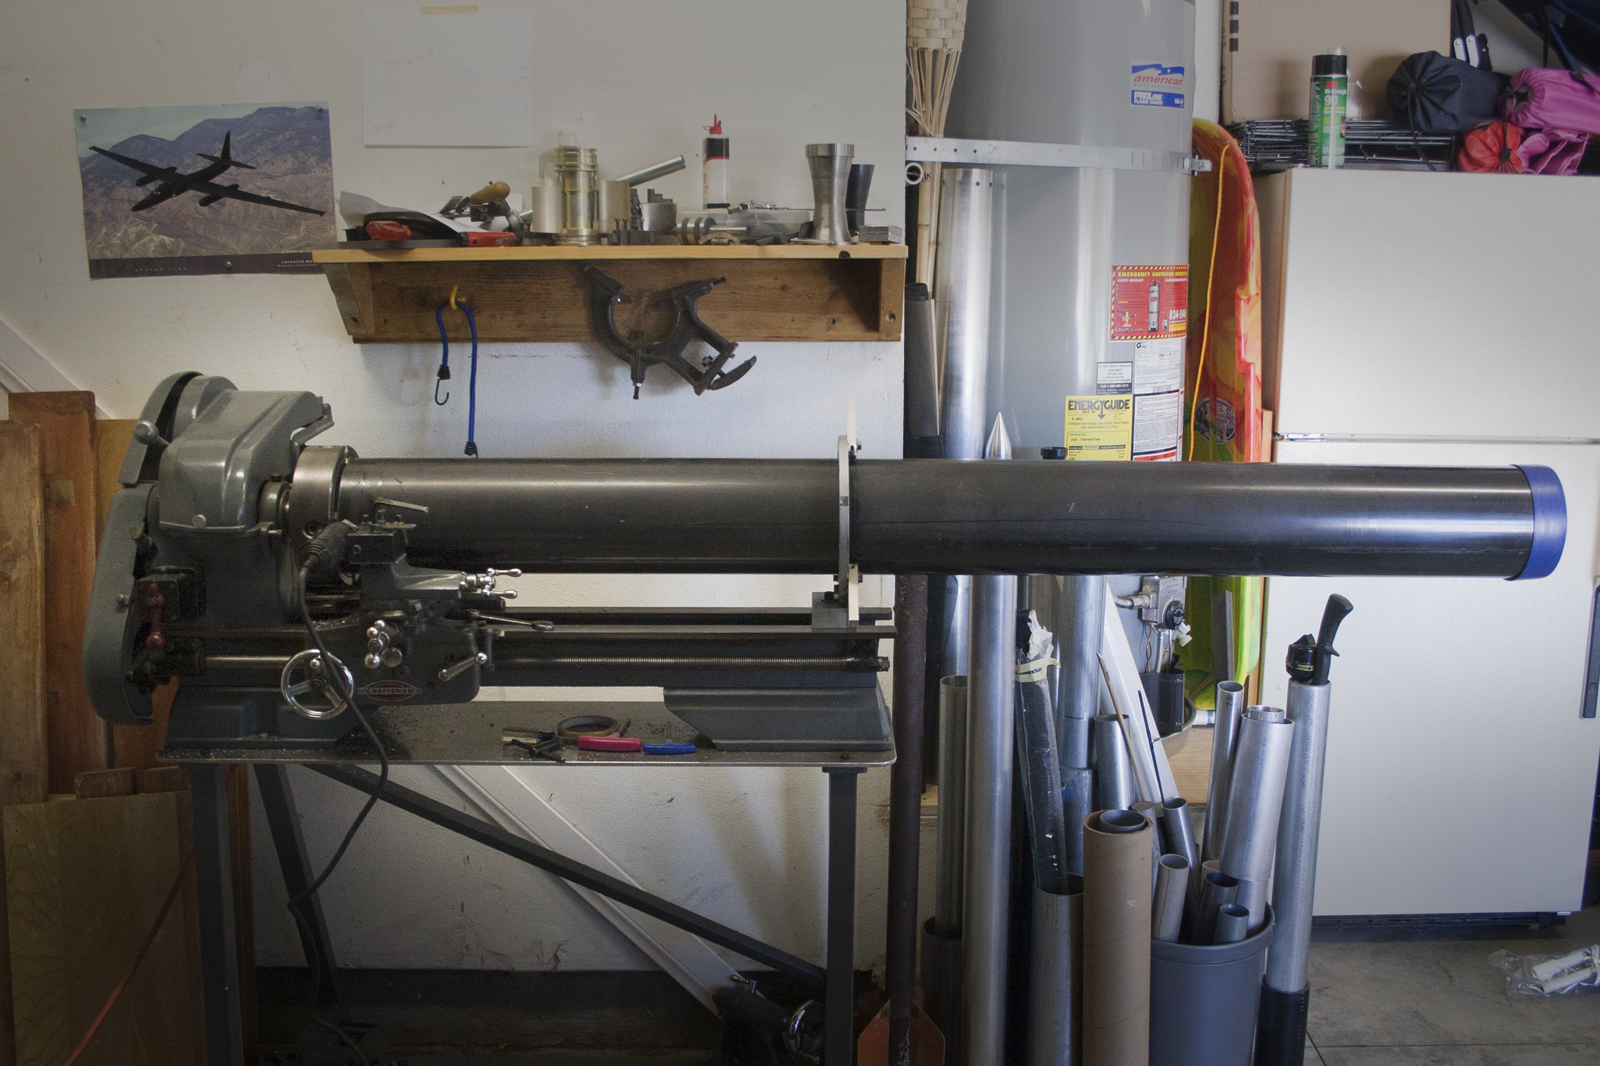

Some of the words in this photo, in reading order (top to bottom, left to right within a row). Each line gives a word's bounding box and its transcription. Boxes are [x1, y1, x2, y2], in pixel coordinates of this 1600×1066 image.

[1133, 75, 1183, 86] american
[1325, 81, 1339, 89] 3M
[1324, 95, 1339, 106] 90
[1068, 399, 1130, 411] ENERGYGUIDE
